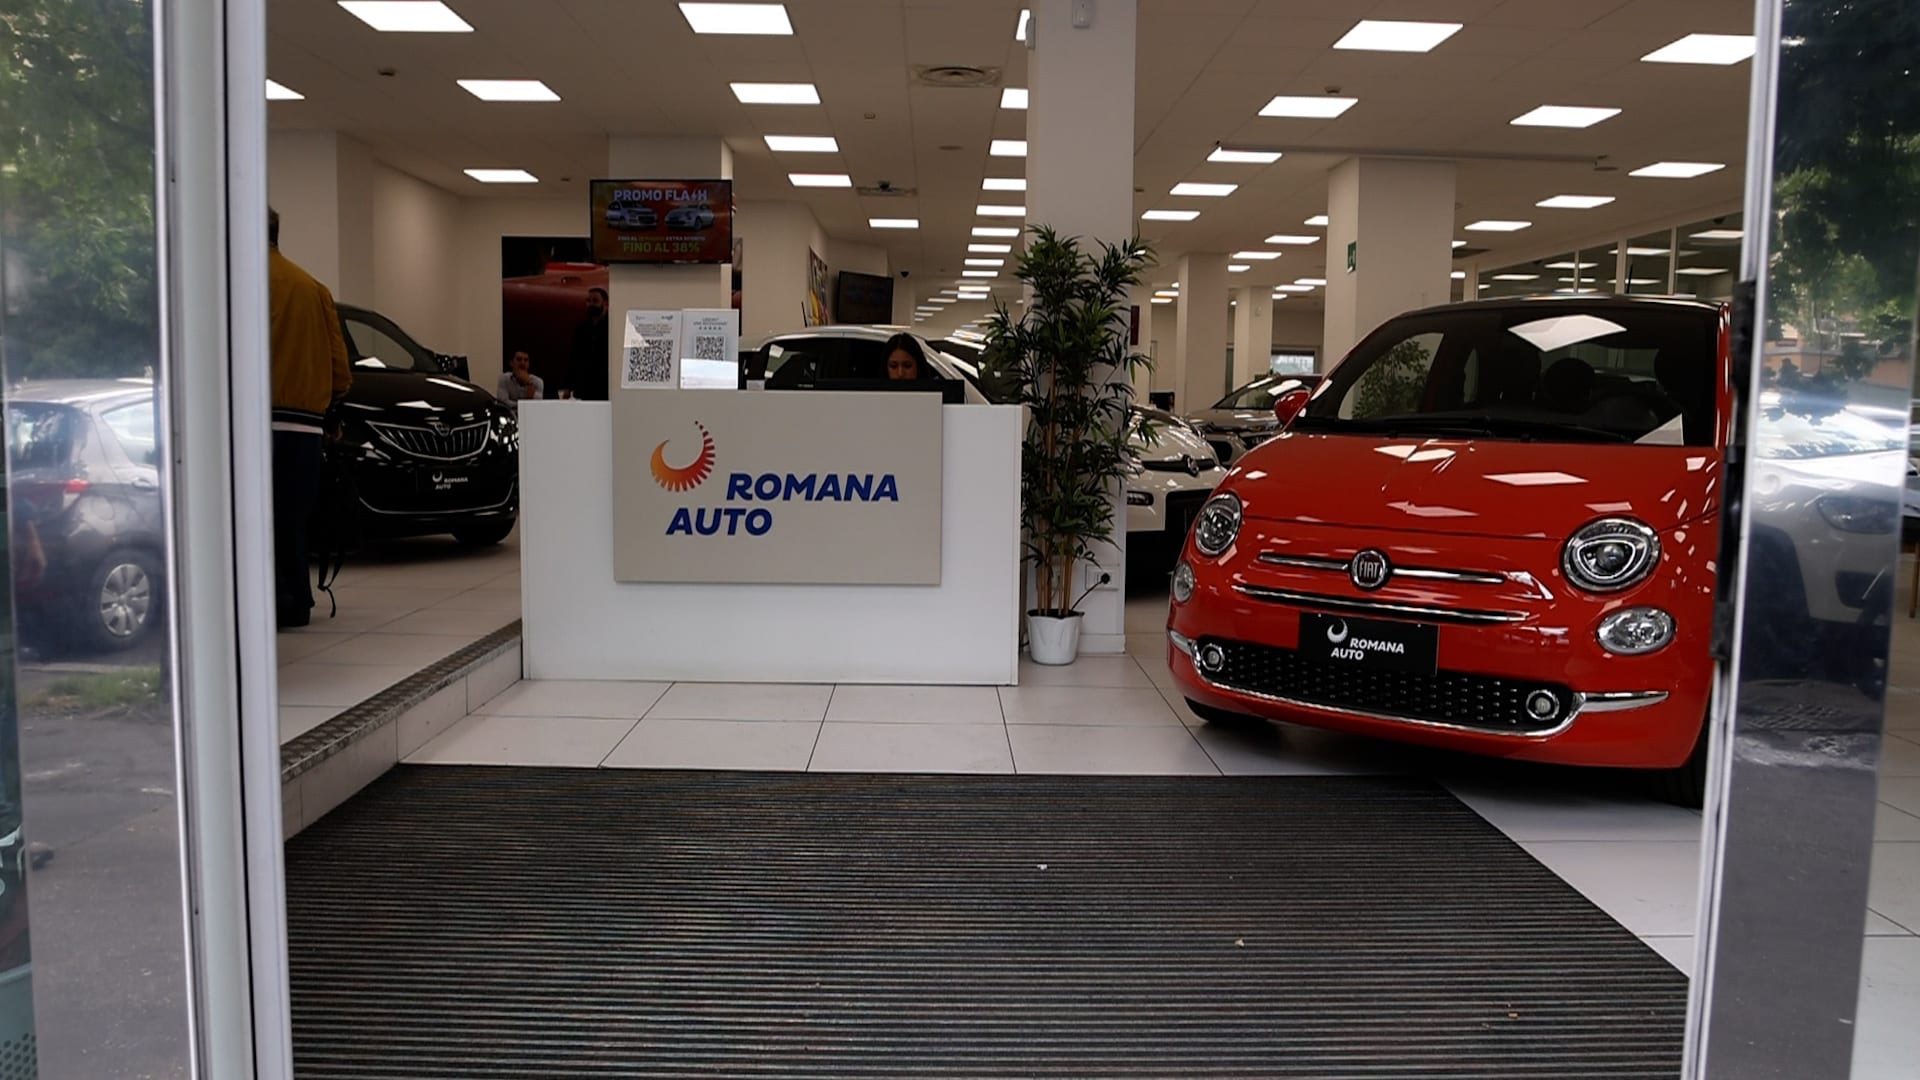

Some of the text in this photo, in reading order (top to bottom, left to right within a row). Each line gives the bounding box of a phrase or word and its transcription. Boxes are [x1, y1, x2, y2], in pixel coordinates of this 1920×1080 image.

[614, 190, 662, 201] PROMO
[623, 242, 700, 252] FINO AL 38%
[726, 473, 899, 502] ROMANA
[665, 508, 772, 536] AUTO
[1359, 559, 1380, 578] FIAT
[1330, 647, 1364, 660] AUTO
[1349, 637, 1405, 654] ROMANA
